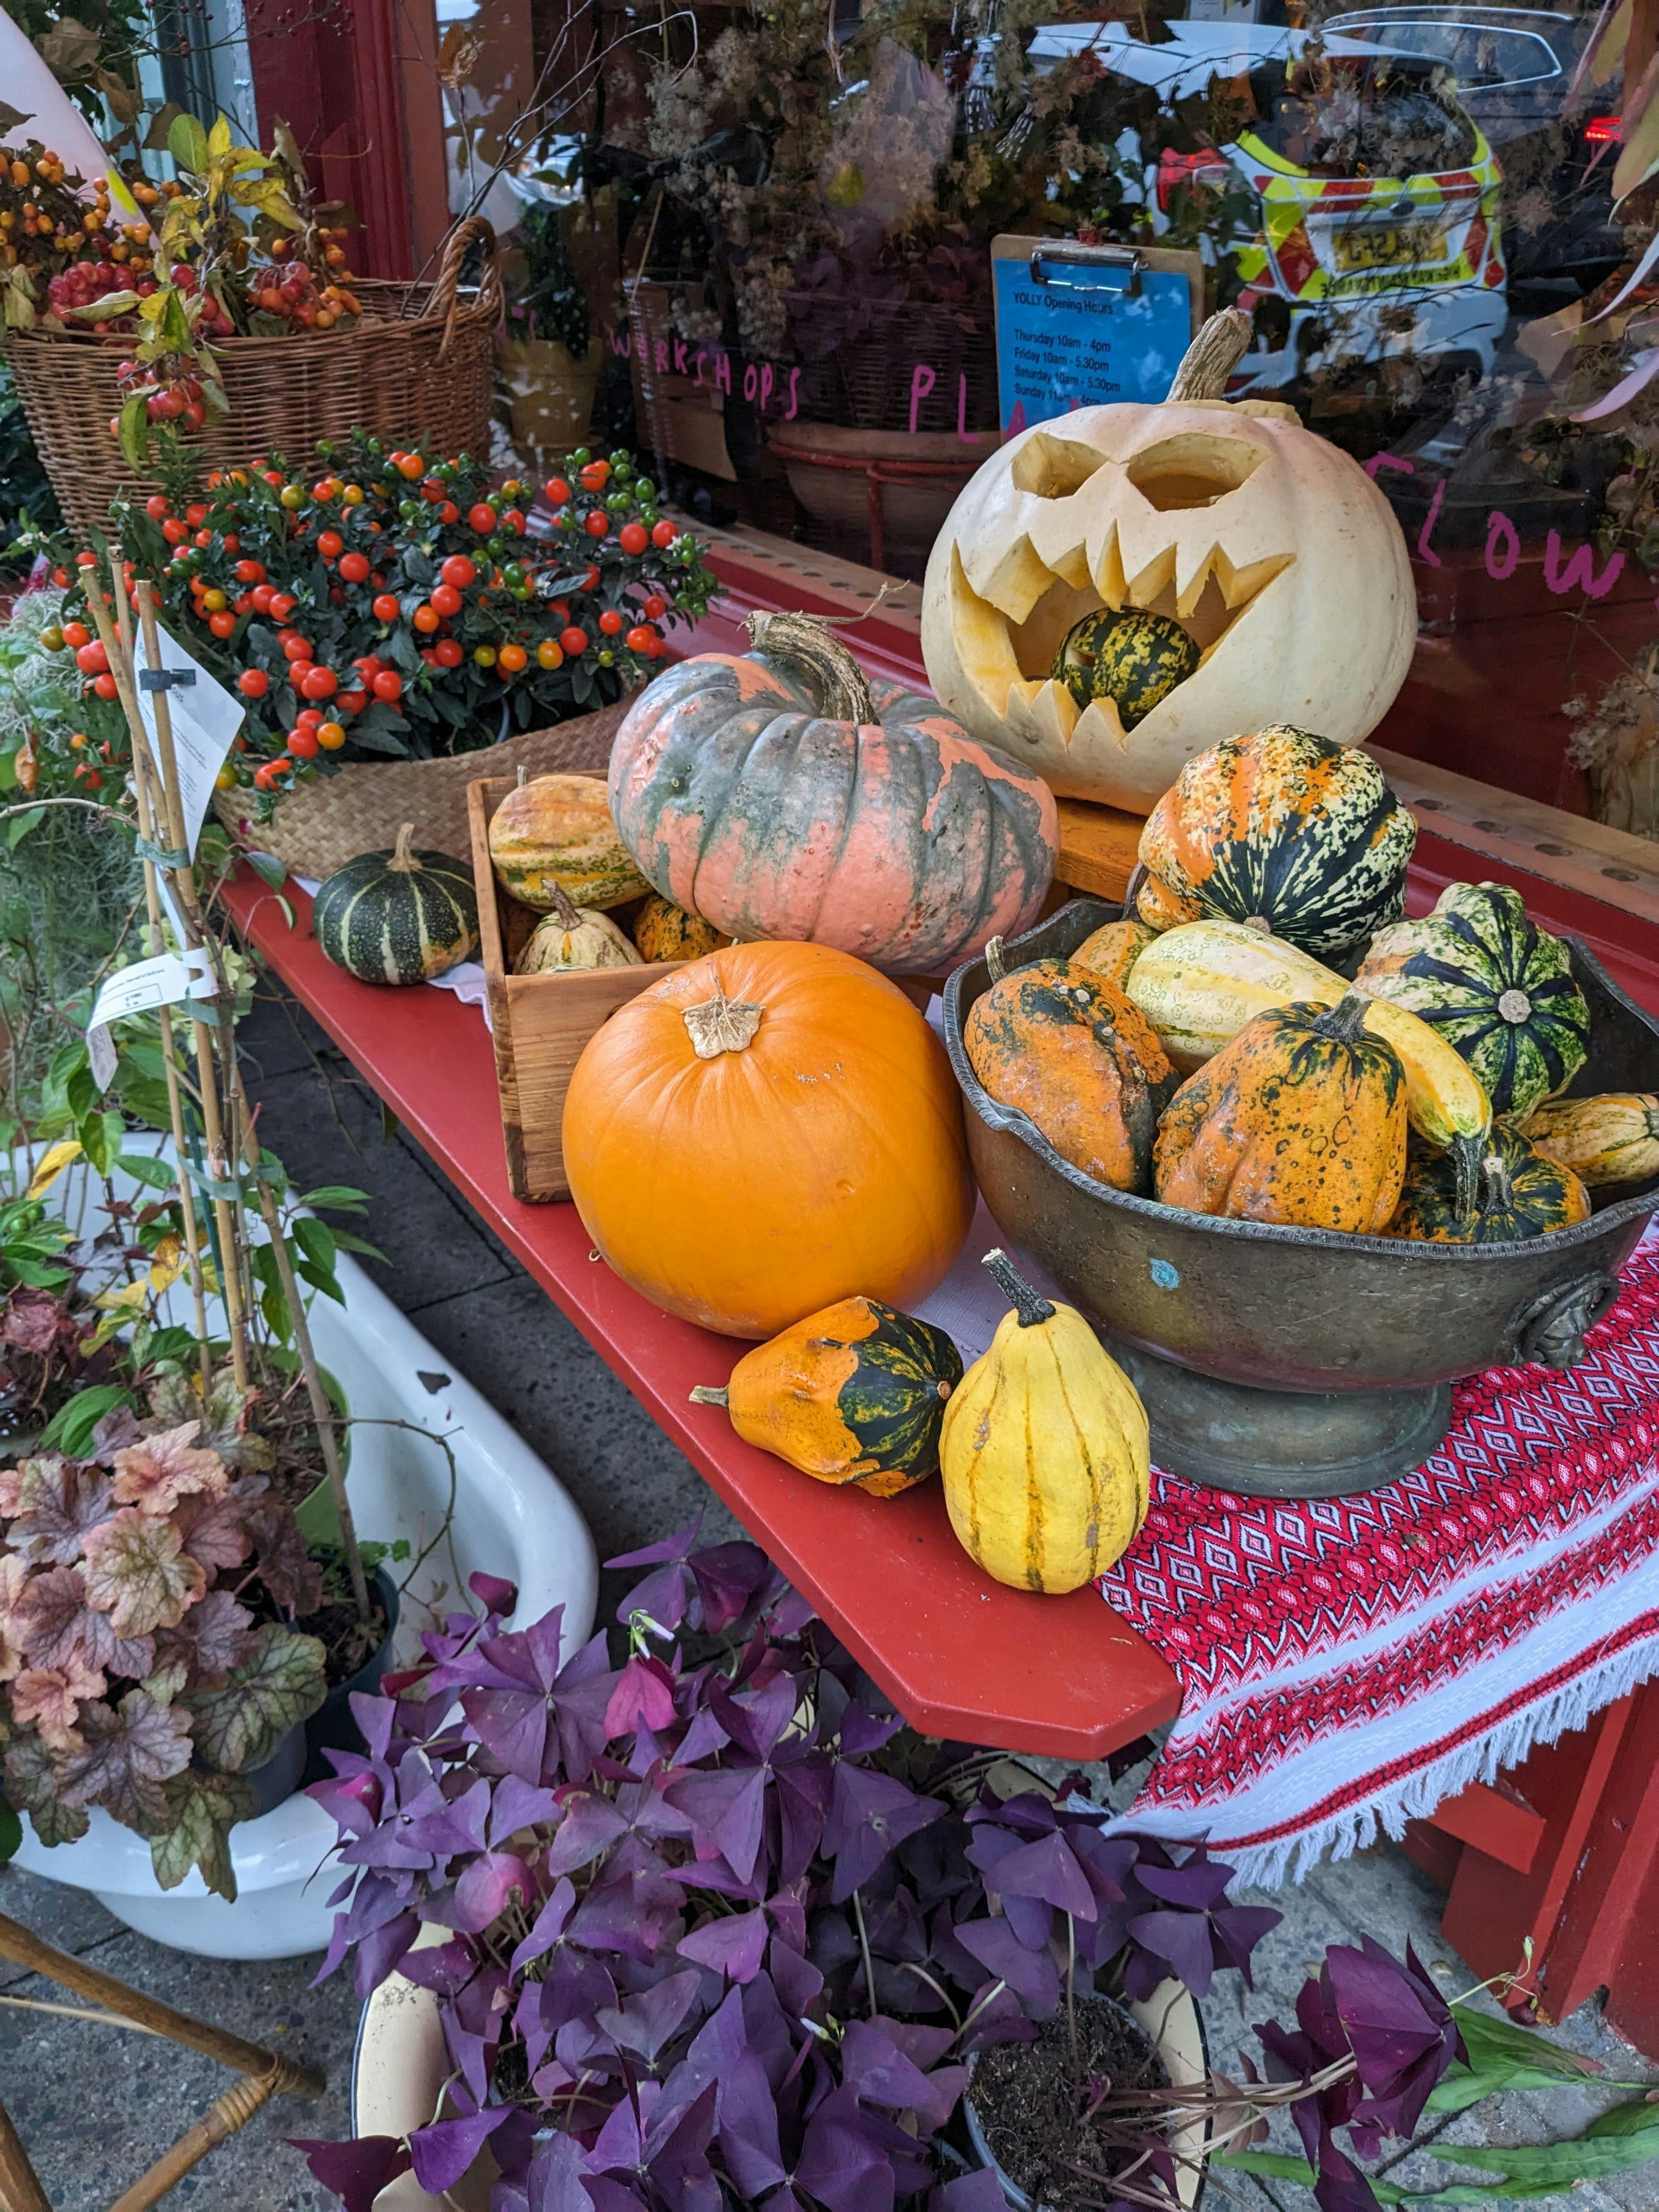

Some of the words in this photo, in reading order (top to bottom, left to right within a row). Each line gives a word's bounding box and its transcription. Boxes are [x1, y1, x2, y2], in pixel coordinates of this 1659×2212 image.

[1013, 292, 1041, 306] YOLLY
[1045, 295, 1082, 314] Opening
[1084, 300, 1114, 314] Hours
[1014, 329, 1054, 347] Thursday
[1057, 335, 1081, 349] 10am
[1090, 338, 1111, 353] 4pm
[1014, 347, 1040, 364] Friday
[1042, 352, 1067, 365] 10am
[1075, 356, 1109, 372] 5.30pm
[1014, 365, 1051, 383] Saturday
[1054, 372, 1079, 386] 10am
[1087, 377, 1121, 393] 5.30pm
[1014, 382, 1046, 400] Sunday
[1048, 389, 1071, 403] 11am
